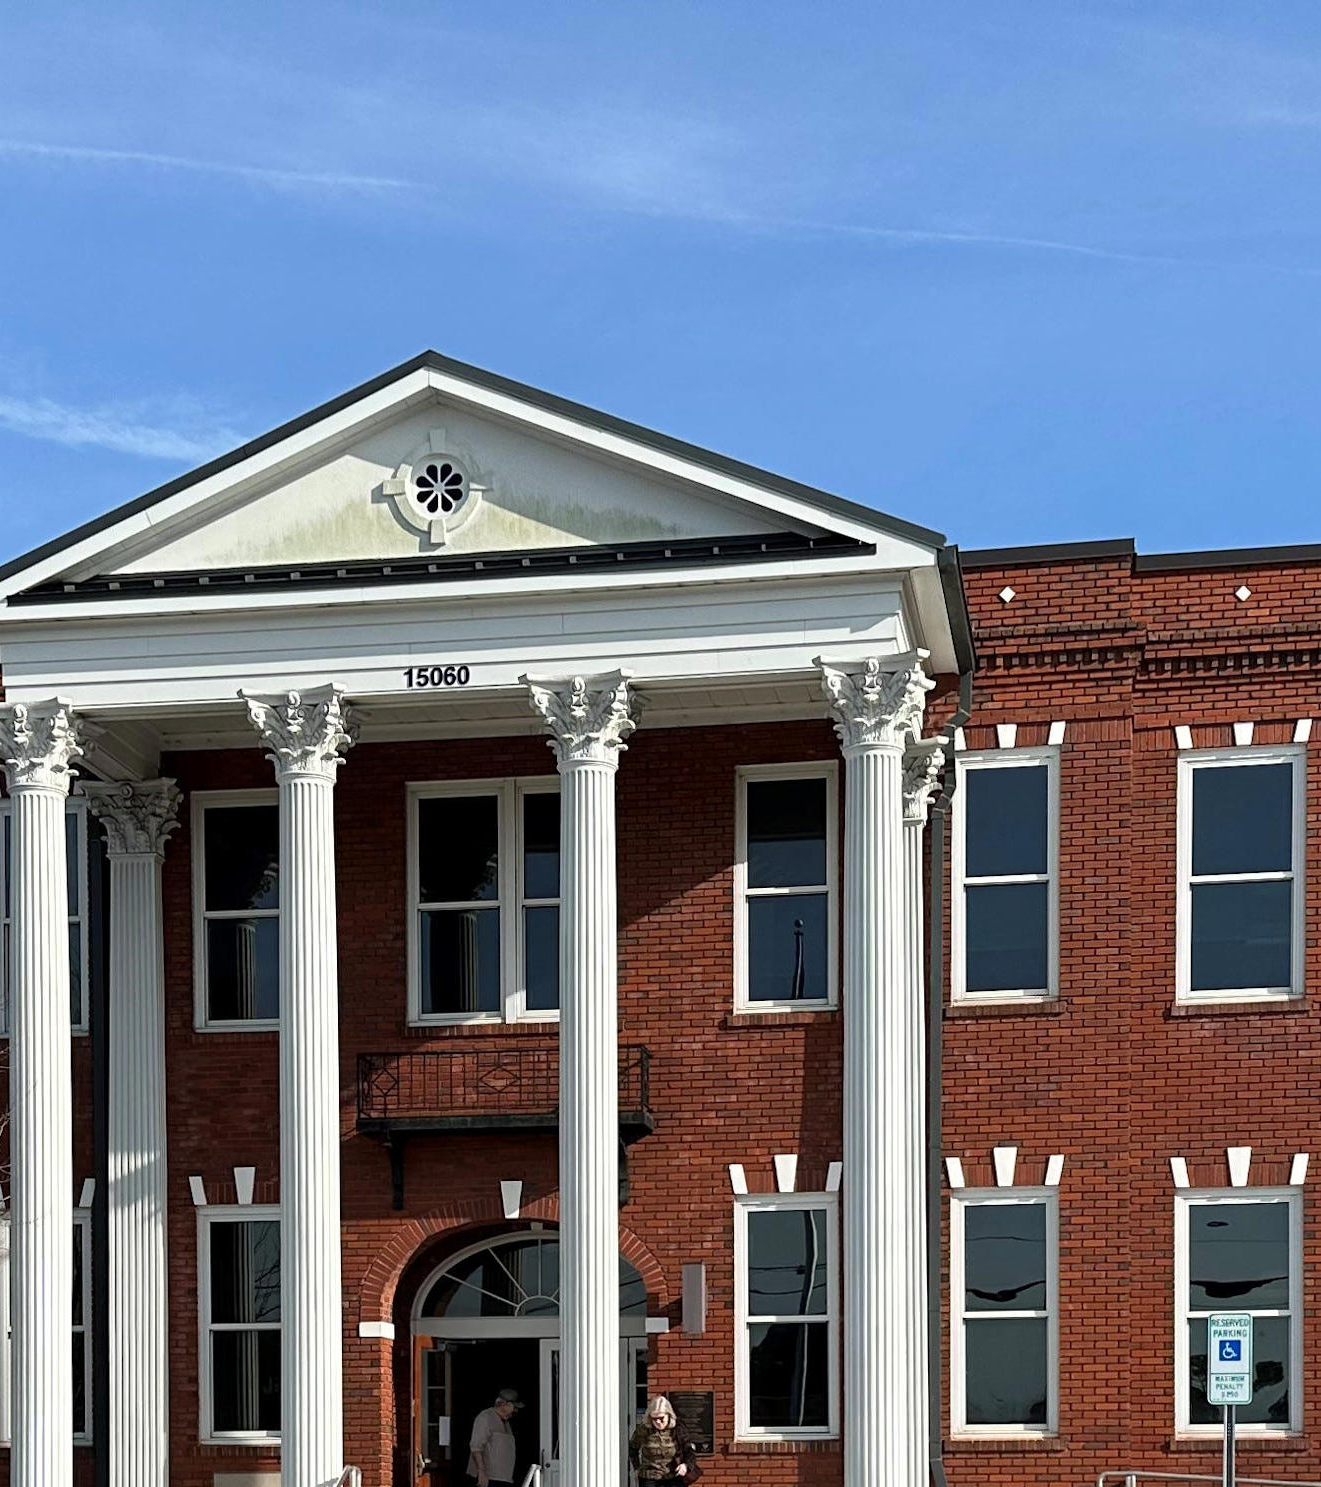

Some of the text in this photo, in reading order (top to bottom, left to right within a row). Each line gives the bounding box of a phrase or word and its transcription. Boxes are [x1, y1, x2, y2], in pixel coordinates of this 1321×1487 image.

[403, 665, 470, 688] 15060
[1211, 1319, 1249, 1328] RESERVED
[1213, 1329, 1248, 1338] PARKING
